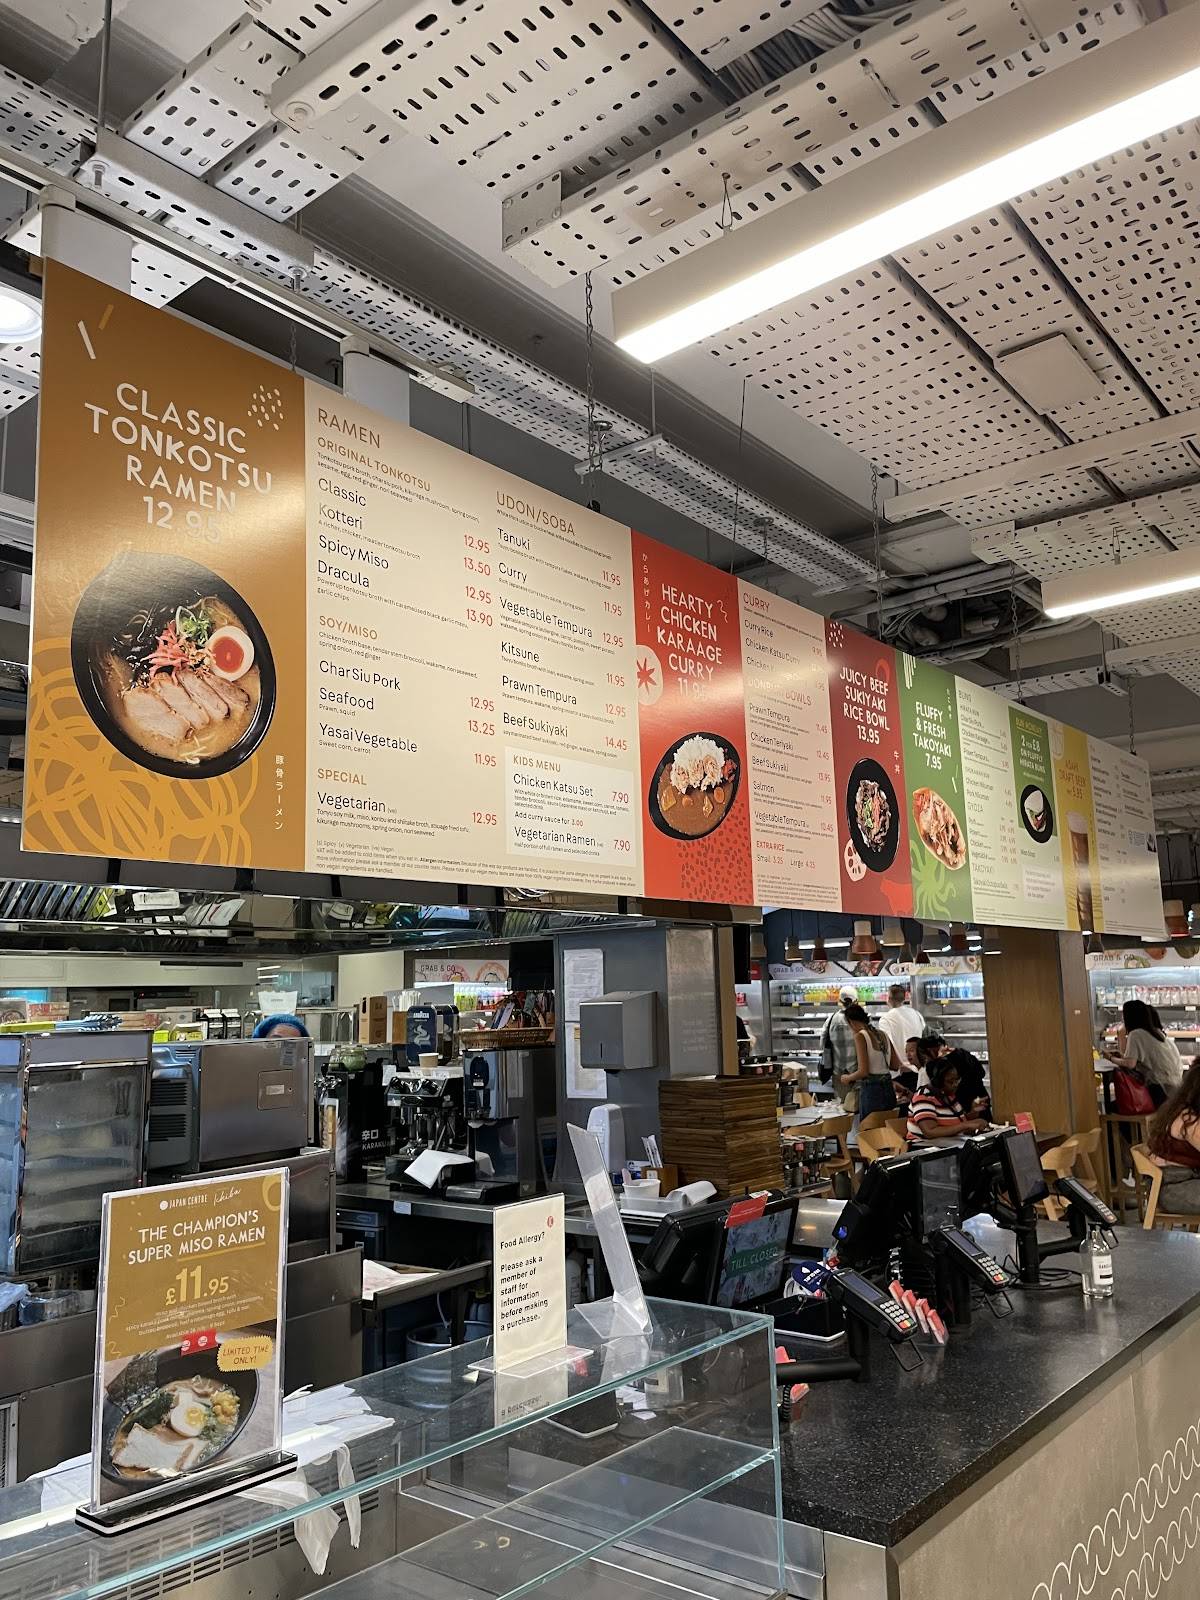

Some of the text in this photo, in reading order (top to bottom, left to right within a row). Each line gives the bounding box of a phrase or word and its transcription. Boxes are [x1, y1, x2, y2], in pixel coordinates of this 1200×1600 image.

[116, 383, 246, 453] CLASSIC
[318, 408, 380, 449] RAMEN
[84, 402, 272, 494] TONKOTSU
[318, 437, 431, 491] ORIGINAL TONKOTSU
[126, 454, 236, 514] RAMEN
[319, 478, 366, 507] Classic
[319, 503, 363, 530] Kotteri
[496, 490, 575, 536] UDON/SOBA
[464, 534, 490, 554] 12.95
[497, 527, 530, 550] Tanuki
[319, 534, 356, 560] Spicy
[359, 548, 388, 569] Miso
[318, 560, 369, 588] Dracula
[464, 557, 491, 576] 13.50
[498, 562, 527, 584] Curry
[602, 570, 621, 586] 11.95
[466, 585, 491, 604] 12.95
[662, 583, 713, 618] HEARTY
[743, 593, 770, 613] CURRY
[467, 609, 493, 627] 13.90
[499, 596, 552, 624] Vegetable
[552, 614, 592, 638] Tempura
[604, 601, 622, 616] 11.95
[319, 615, 378, 640] SOY/MISO
[661, 606, 717, 641] CHICKEN
[744, 619, 774, 639] Curry Rice
[602, 632, 623, 648] 12.95
[657, 626, 722, 665] KARAAGE
[745, 637, 770, 656] Chicken
[770, 647, 785, 662] Katsu
[501, 641, 540, 663] Kitsune
[320, 660, 351, 678] Char
[352, 668, 370, 683] Siu
[374, 673, 401, 690] Pork
[669, 653, 713, 681] CURRY
[606, 672, 625, 687] 11.95
[840, 666, 888, 696] JUICY BEEF
[320, 688, 374, 710] Seafood
[502, 675, 577, 705] Prawn Tempura
[845, 685, 886, 712] SUKIYAKI
[470, 697, 494, 712] 12.95
[605, 703, 626, 718] 12.95
[749, 702, 767, 717] Prawn
[767, 707, 790, 724] Tempura
[916, 701, 943, 723] FLUFFY
[503, 712, 568, 739] Beef Sukiyaki
[843, 702, 890, 731] RICE BOWL
[320, 722, 417, 752] Yasai Vegetable
[468, 720, 495, 736] 13.25
[857, 725, 880, 745] 13.95
[916, 718, 946, 740] & FRESH
[605, 736, 627, 751] 14.45
[750, 731, 774, 746] Chicken
[913, 733, 952, 758] TAKOYAKI
[1020, 735, 1026, 747] 2
[474, 753, 496, 767] 11.95
[513, 754, 561, 772] KIDS MENU
[751, 756, 788, 775] Beef Sukiyaki
[926, 753, 942, 770] 7.95
[318, 768, 367, 785] SPECIAL
[514, 773, 593, 797] Chicken Katsu Set
[612, 791, 629, 804] 7.90
[753, 781, 774, 794] Salmon
[318, 791, 386, 812] Vegetarian
[472, 812, 497, 826] 12.95
[515, 811, 526, 819] Add
[528, 813, 543, 823] curry
[561, 817, 570, 825] for
[754, 811, 806, 831] Vegetable Tempura
[514, 826, 596, 847] Vegetarian Ramen
[613, 839, 630, 852] 7.90
[756, 840, 785, 853] EXTRA RICE
[757, 854, 772, 864] Small
[790, 858, 804, 870] Large
[1094, 954, 1114, 962] GRAB
[1123, 953, 1134, 962] GO
[447, 964, 456, 972] GO
[169, 1197, 186, 1209] JAPAN
[187, 1194, 208, 1206] CENTRE
[138, 1210, 258, 1243] THE CHAMPION'S
[128, 1226, 265, 1265] SUPER MISO RAMEN
[500, 1232, 545, 1250] Food Allergy?
[500, 1261, 523, 1272] Please
[525, 1256, 537, 1266] ask
[732, 1247, 778, 1271] TILL CLOSED
[165, 1265, 229, 1306] £11.95
[500, 1267, 537, 1284] member of
[500, 1282, 528, 1296] staff for
[500, 1291, 540, 1307] information
[500, 1299, 548, 1320] before making
[507, 1314, 541, 1331] purchase.
[223, 1344, 269, 1357] LIMITED TIME
[233, 1356, 257, 1365] ONLY!
